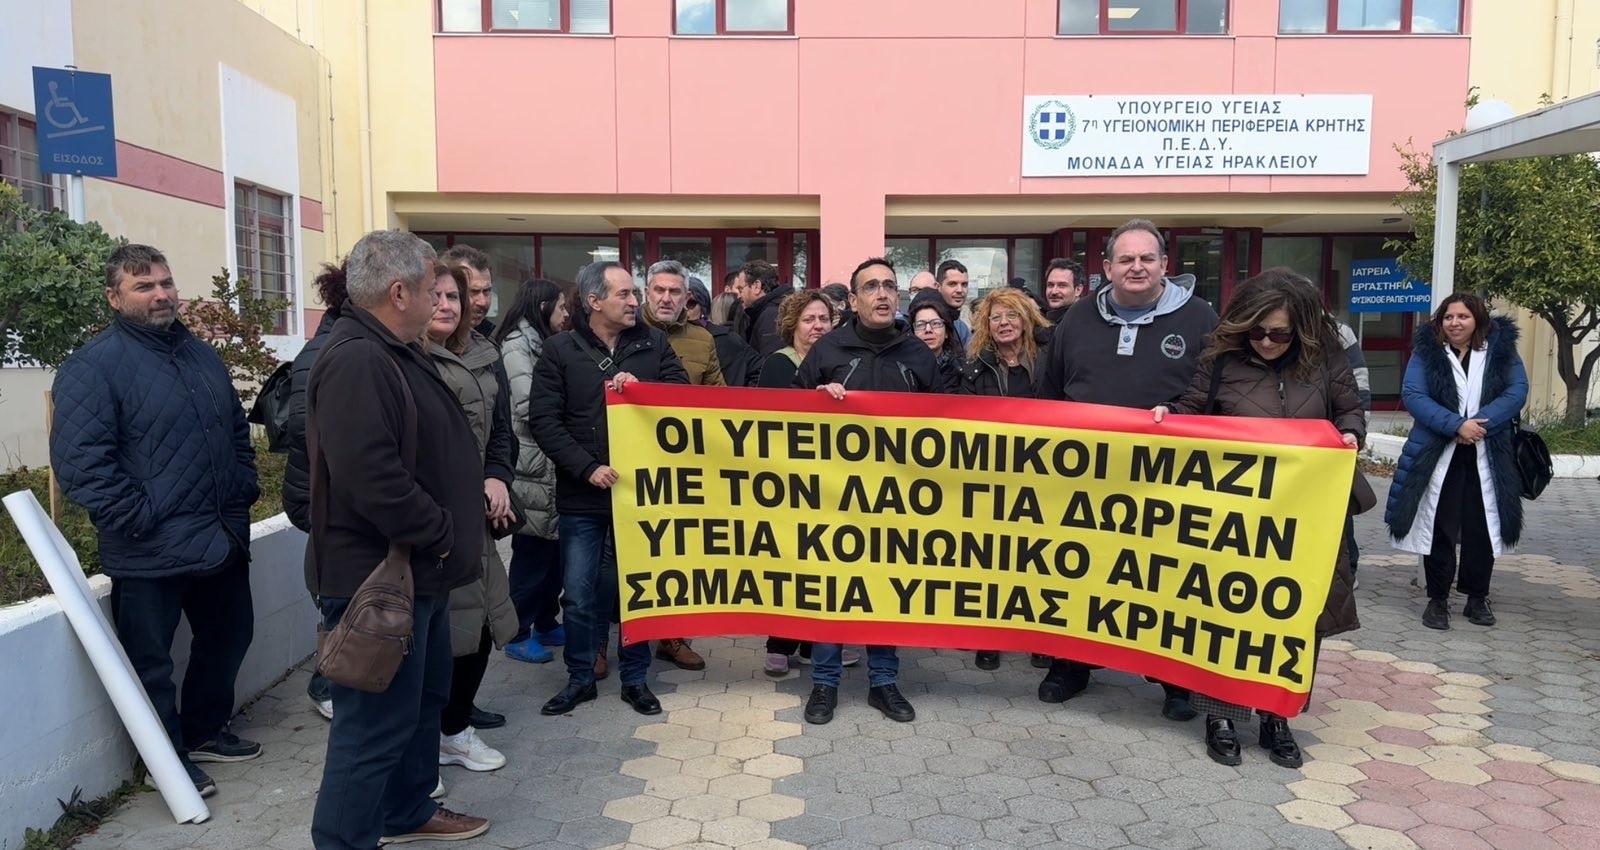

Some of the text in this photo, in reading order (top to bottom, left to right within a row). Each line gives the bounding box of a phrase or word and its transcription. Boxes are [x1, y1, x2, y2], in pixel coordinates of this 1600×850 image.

[1117, 100, 1282, 115] ΥΠΟΥΡΓΕΙΟ ΥΓΕΙΑΣ
[1103, 119, 1205, 133] ΥΓΕΙΟΝΟΜΙΚΗ
[1212, 119, 1299, 133] ΠΕΡΙΦΕΡΕΙΑ
[1305, 119, 1366, 132] ΚΡΗΤΗΣ
[1162, 137, 1233, 151] Π.Ε.Δ.Υ.
[53, 153, 104, 165] ΕΙΣΟΔΟΣ
[1067, 155, 1318, 170] ΜΟΝΑΔΑ ΥΓΕΙΑΣ ΗΡΑΚΛΕΙΟΥ
[1352, 267, 1391, 276] ΙΑΤΡΕΙΑ
[655, 416, 1278, 500] ΟΙ ΥΓΕΙΟΝΟΜΙΚΟΙ ΜΑΖΙ
[634, 467, 1298, 561] ΜΕ ΤΟΝ ΛΑΟ ΓΙΑ ΔΩΡΕΑΝ
[637, 518, 1302, 620] ΥΓΕΙΑ ΚΟΙΝΩΝΙΚΟ ΑΓΑΘΟ
[625, 568, 1307, 685] ΣΩΜΑΤΕΙΑ ΥΓΕΙΑΣ ΚΡΗΤΗΣ
